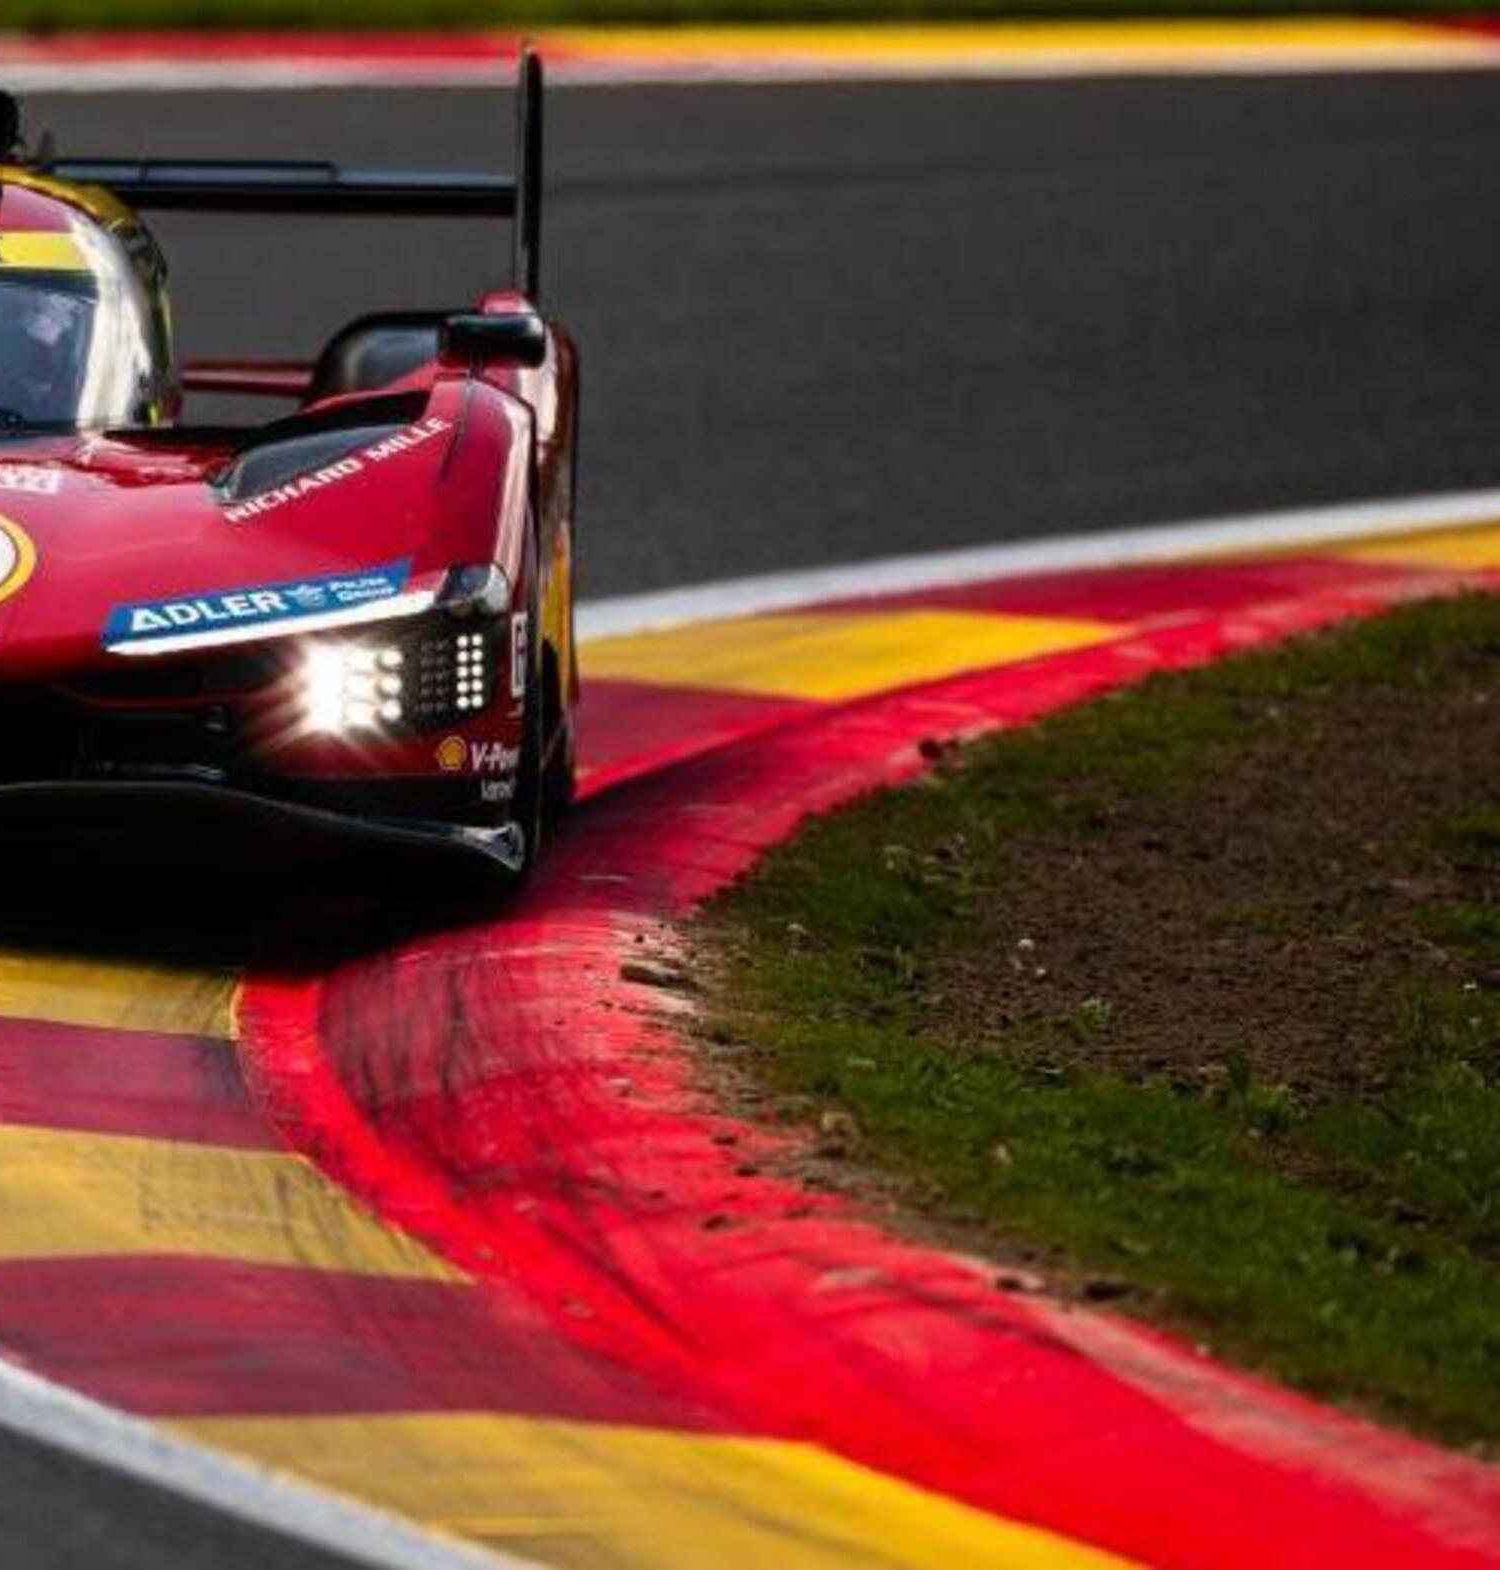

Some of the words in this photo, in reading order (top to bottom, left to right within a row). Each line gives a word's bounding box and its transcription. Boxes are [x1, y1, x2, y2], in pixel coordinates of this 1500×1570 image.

[224, 457, 363, 524] RICHARD
[365, 415, 454, 464] MILLE
[130, 590, 290, 633] ADLER
